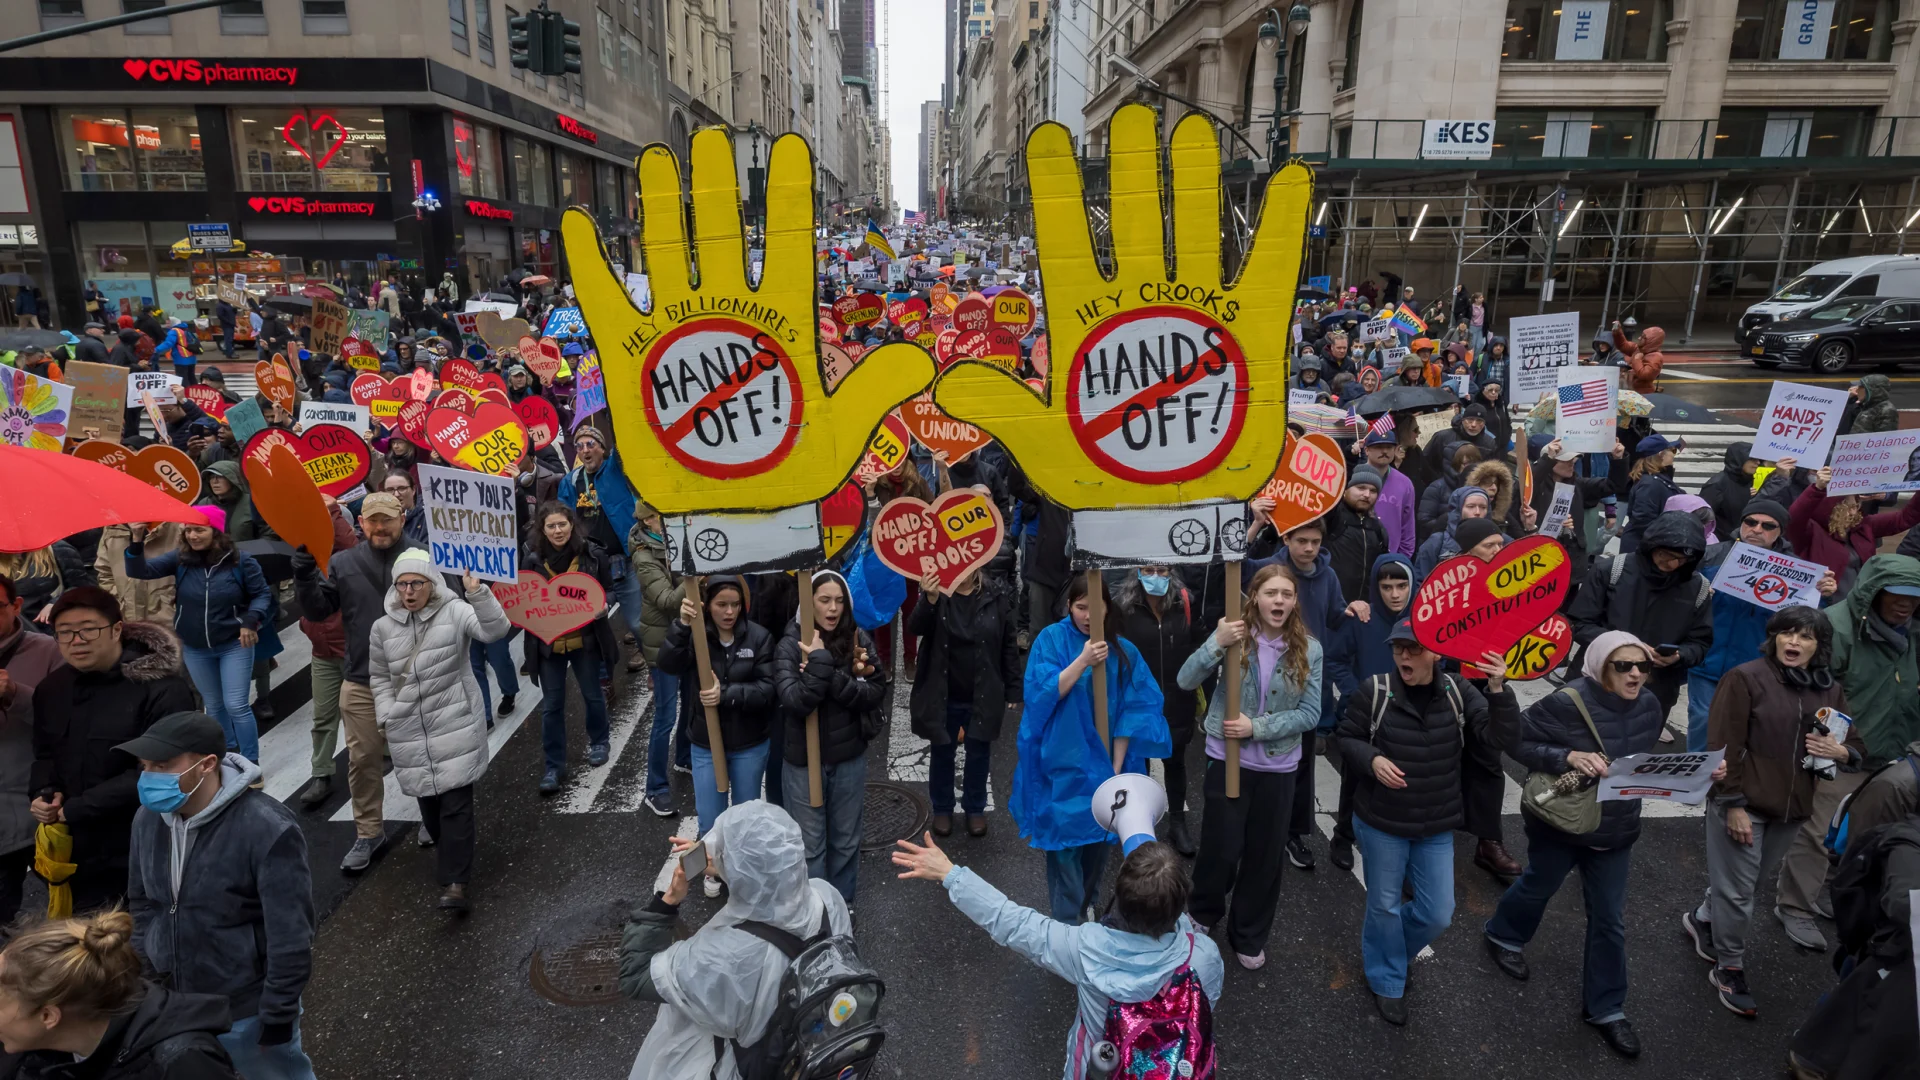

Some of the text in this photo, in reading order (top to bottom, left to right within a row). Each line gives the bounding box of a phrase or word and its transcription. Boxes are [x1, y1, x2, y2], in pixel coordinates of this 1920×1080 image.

[1574, 9, 1592, 42] THE
[1798, 0, 1818, 46] GRAD
[149, 59, 298, 86] CVS pharmacy
[365, 132, 387, 140] balanc
[565, 120, 597, 144] CVS pharmacy
[1444, 122, 1490, 144] KES
[267, 197, 375, 216] CVS pharmacy
[475, 202, 513, 222] CVS pharmacy
[220, 284, 239, 301] Join
[317, 301, 344, 320] HANDS
[844, 307, 881, 322] GREENLAND
[889, 302, 906, 313] HANDS
[958, 309, 988, 323] HANDS
[999, 301, 1027, 316] OUR
[1075, 289, 1123, 326] HEY
[621, 295, 799, 358] HEY BILLIONAIRES
[966, 320, 989, 330] OFF!
[1366, 325, 1388, 336] OFF!
[1367, 320, 1387, 328] HANDS
[1394, 310, 1422, 333] RESIST
[521, 345, 541, 354] HANDS
[955, 332, 986, 354] HANDS
[995, 335, 1015, 346] OUR
[1523, 344, 1568, 357] HANDS
[531, 360, 560, 372] DIVERSITY
[1083, 326, 1229, 399] HANDS
[1523, 353, 1569, 369] OFF!
[134, 373, 167, 381] HANDS
[257, 366, 274, 379] HANDS
[451, 362, 485, 384] HANDS
[453, 373, 475, 388] OFF!
[650, 332, 780, 411] HANDS
[1539, 373, 1559, 381] LIBRARIE
[135, 379, 167, 392] OFF!
[188, 387, 221, 403] HANDS
[270, 385, 293, 402] SOIL
[354, 379, 383, 394] HANDS
[361, 388, 382, 399] OFF!
[391, 386, 413, 400] OU
[1291, 391, 1314, 400] Trump
[1795, 393, 1834, 405] Medicare
[1, 407, 34, 427] HANDS
[304, 408, 358, 423] CONSTITUTION
[399, 400, 427, 422] HANDS
[521, 404, 551, 420] OUR
[692, 375, 783, 448] OFF!
[1121, 381, 1229, 451] OFF!
[1771, 404, 1827, 426] HANDS
[403, 412, 427, 433] OFF!
[434, 415, 468, 443] HANDS
[920, 419, 981, 442] UNIONS
[3, 428, 25, 443] OFF
[308, 428, 353, 452] OUR
[448, 427, 471, 449] OFF!
[473, 428, 512, 458] OUR
[1771, 421, 1825, 446] OFF!!
[1838, 435, 1917, 451] The balance
[97, 450, 127, 466] NDS
[471, 441, 524, 475] VOTES
[872, 433, 900, 463] UR
[1767, 441, 1808, 455] Medicaid
[1834, 450, 1891, 465] power is
[303, 452, 354, 476] ETERANS
[312, 464, 356, 484] ENEFITS
[1294, 444, 1338, 493] OUR
[1830, 461, 1908, 477] the scale of
[159, 464, 189, 492] OUR
[1828, 478, 1872, 492] peace.
[429, 476, 514, 512] KEEP YOUR
[946, 505, 988, 533] OUR
[1552, 504, 1569, 517] OFF!
[430, 506, 516, 540] KLEPTOCRACY
[876, 508, 935, 543] HANDS
[442, 531, 503, 546] OUT OF OUR
[893, 527, 938, 557] OFF!
[431, 541, 517, 580] DEMOCRACY
[918, 537, 984, 574] BOOKS
[1767, 554, 1796, 569] STILL
[1495, 552, 1547, 590] OUR
[1736, 553, 1758, 568] NOT
[1757, 559, 1772, 572] MY
[1768, 563, 1817, 585] PRESIDENT
[493, 579, 541, 601] HANDS
[1420, 559, 1478, 604] HANDS
[1723, 581, 1746, 593] CHEATER
[502, 587, 551, 610] OFF!
[557, 585, 588, 600] OUR
[1416, 581, 1472, 623] OFF!
[524, 601, 595, 620] MUSEUMS
[1434, 578, 1558, 645] CONSTITUTION
[1538, 617, 1568, 641] UR
[1503, 637, 1559, 676] OKS
[1644, 753, 1710, 764] HANDS
[1632, 763, 1701, 777] OFF!
